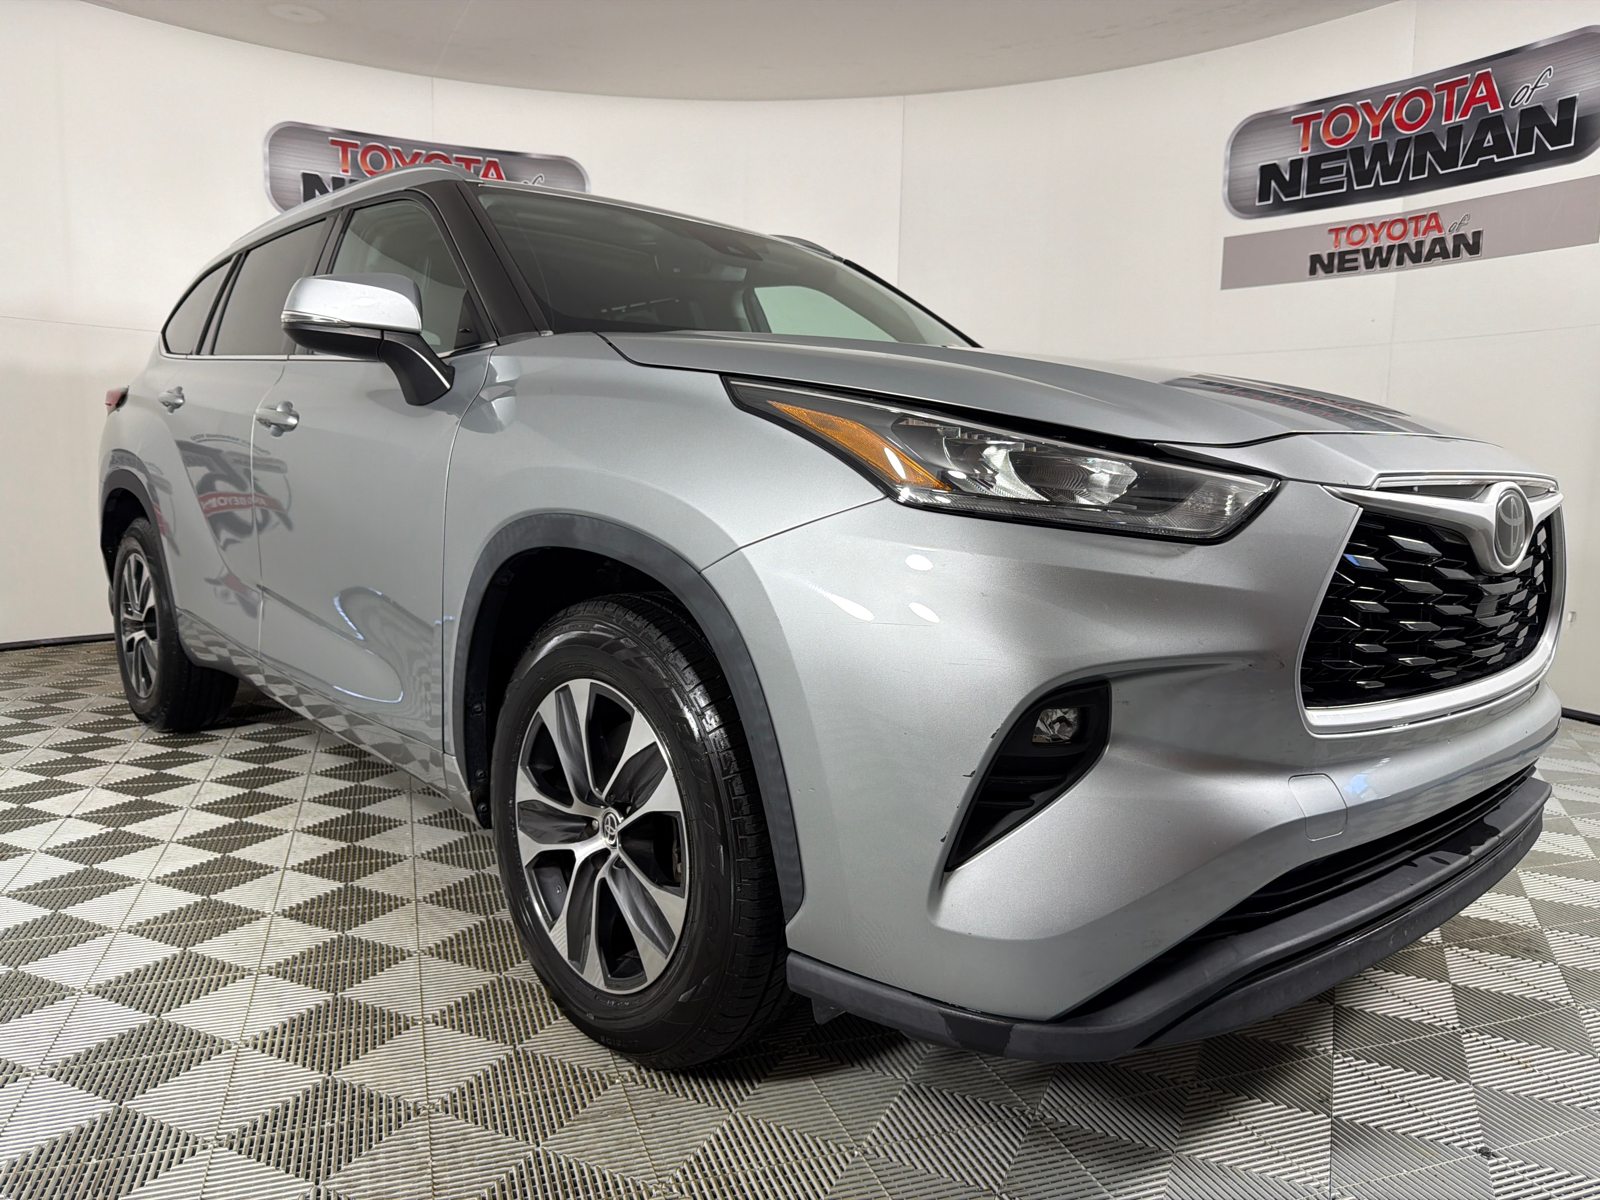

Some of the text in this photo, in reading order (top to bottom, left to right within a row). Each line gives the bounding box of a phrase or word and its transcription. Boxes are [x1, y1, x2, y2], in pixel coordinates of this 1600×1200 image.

[1292, 66, 1553, 154] TOYOTA of
[1256, 94, 1579, 205] NEWNAN
[1309, 229, 1483, 277] NEWNAN
[1328, 211, 1470, 249] TOYOTA of
